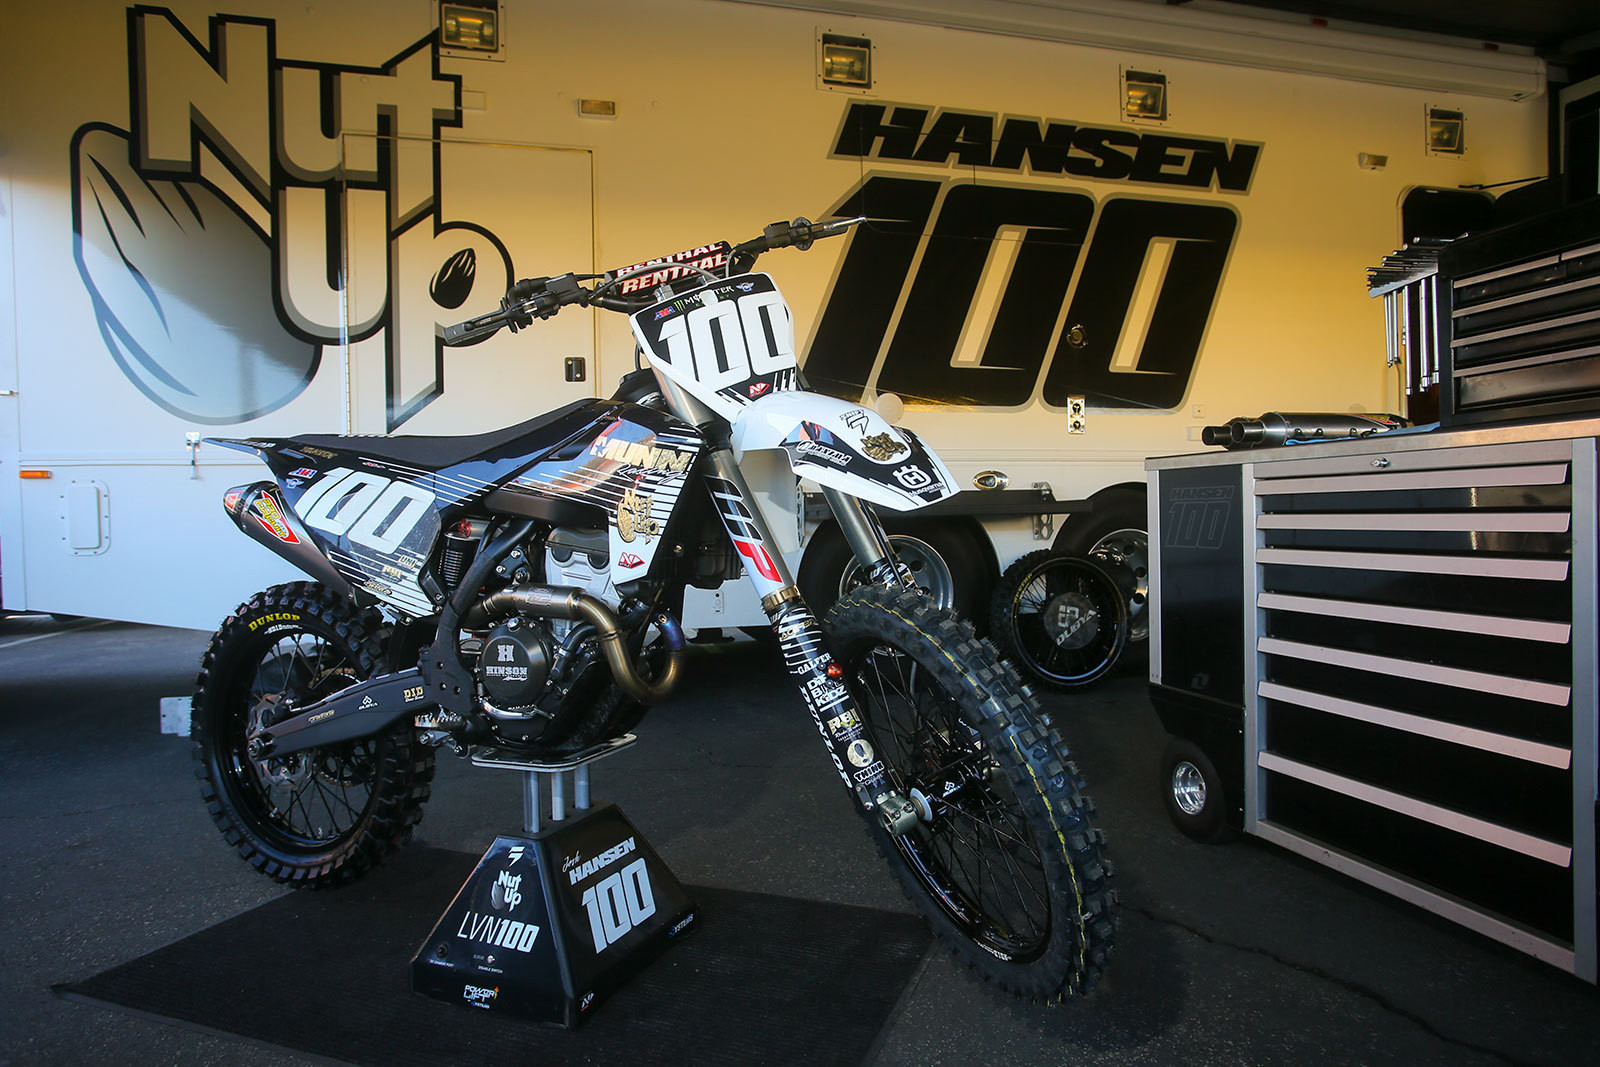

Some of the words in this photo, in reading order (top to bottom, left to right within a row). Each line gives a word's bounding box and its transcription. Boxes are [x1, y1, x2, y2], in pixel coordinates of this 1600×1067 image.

[127, 4, 463, 237] Nut
[829, 98, 1263, 195] HANSEN
[621, 253, 727, 295] RENTHAL
[684, 285, 734, 305] MOTER
[798, 172, 1240, 409] 100
[271, 183, 515, 434] Up
[658, 291, 796, 390] 100
[590, 435, 692, 471] MUNN
[293, 466, 435, 554] 100
[1165, 500, 1231, 549] 100
[248, 612, 301, 631] DUNLOP
[1056, 609, 1097, 646] DUBYA
[486, 666, 527, 676] HINSON
[797, 652, 832, 675] GALFER
[799, 685, 853, 789] DUNLOP
[853, 760, 885, 782] THINK
[498, 870, 522, 891] Nut
[569, 836, 636, 885] HANSEN
[504, 887, 522, 912] Up
[582, 857, 657, 954] 100
[464, 984, 495, 998] POWER
